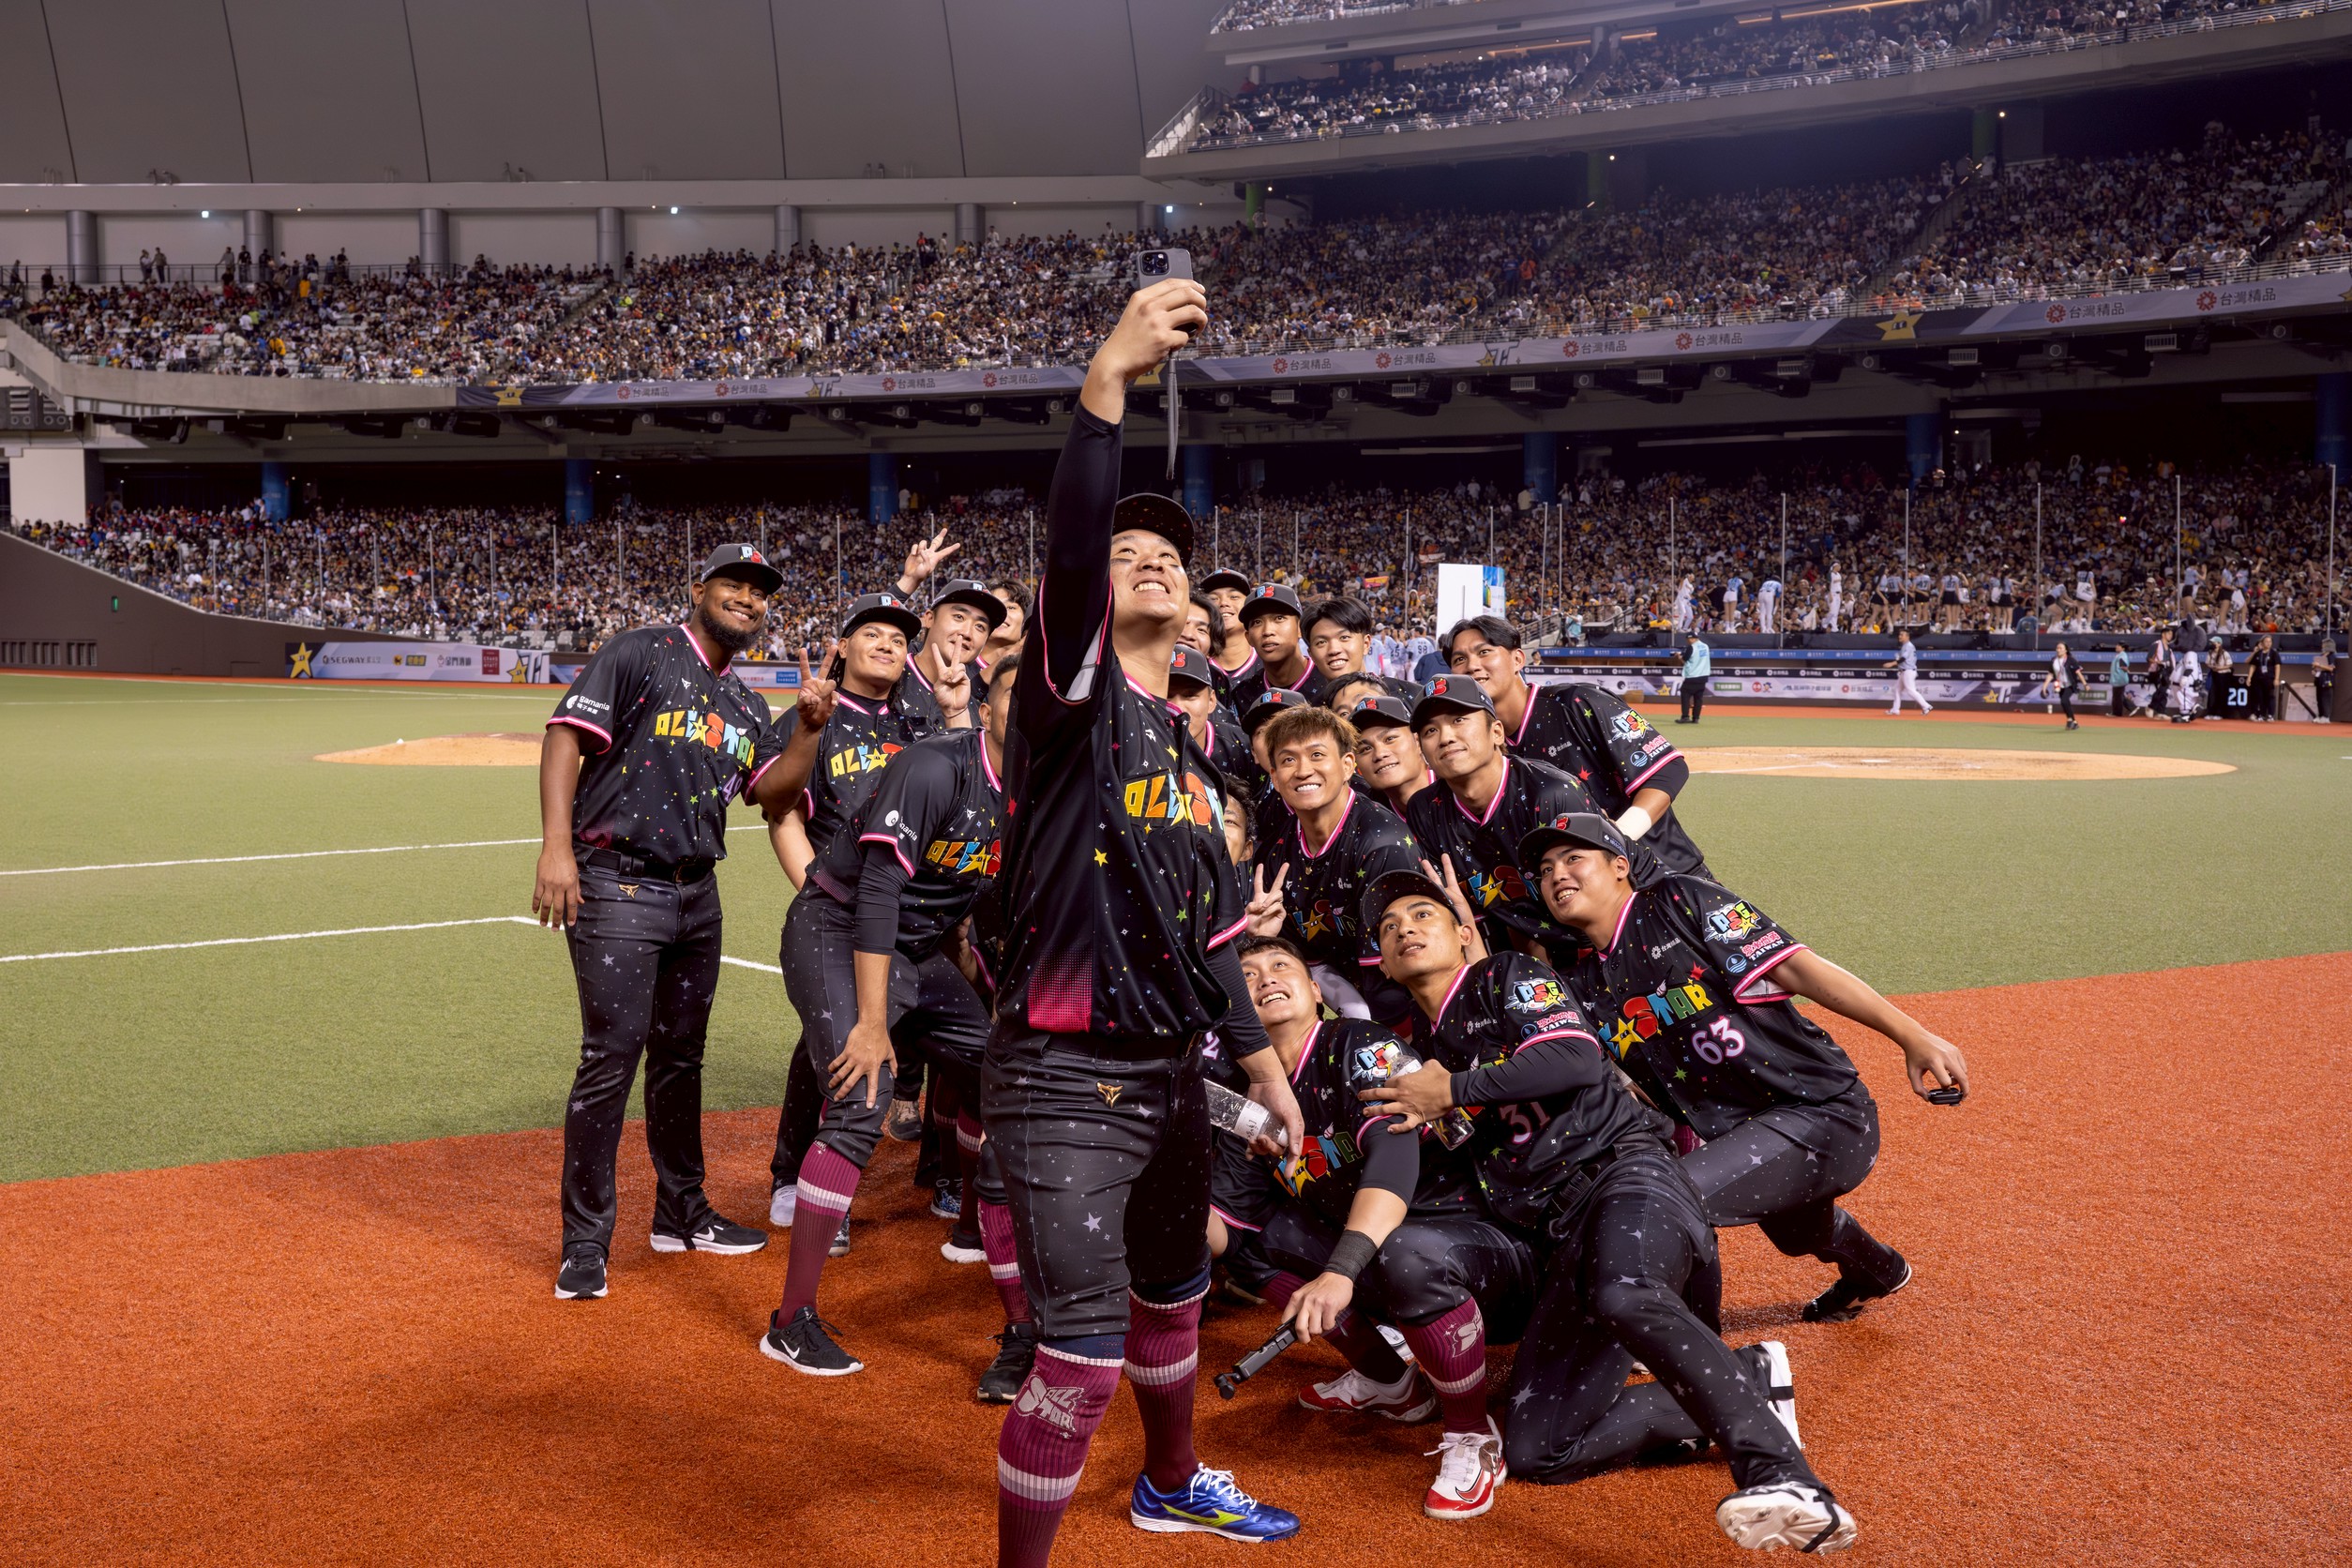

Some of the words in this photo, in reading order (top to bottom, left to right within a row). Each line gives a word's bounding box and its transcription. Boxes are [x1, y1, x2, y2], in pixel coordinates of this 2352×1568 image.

[330, 656, 365, 665] SEGWAY
[579, 695, 611, 711] gamania
[2227, 687, 2248, 706] 20
[1749, 939, 1785, 961] TAIWAN
[1691, 1016, 1746, 1065] 63
[1499, 1100, 1551, 1145] 31
